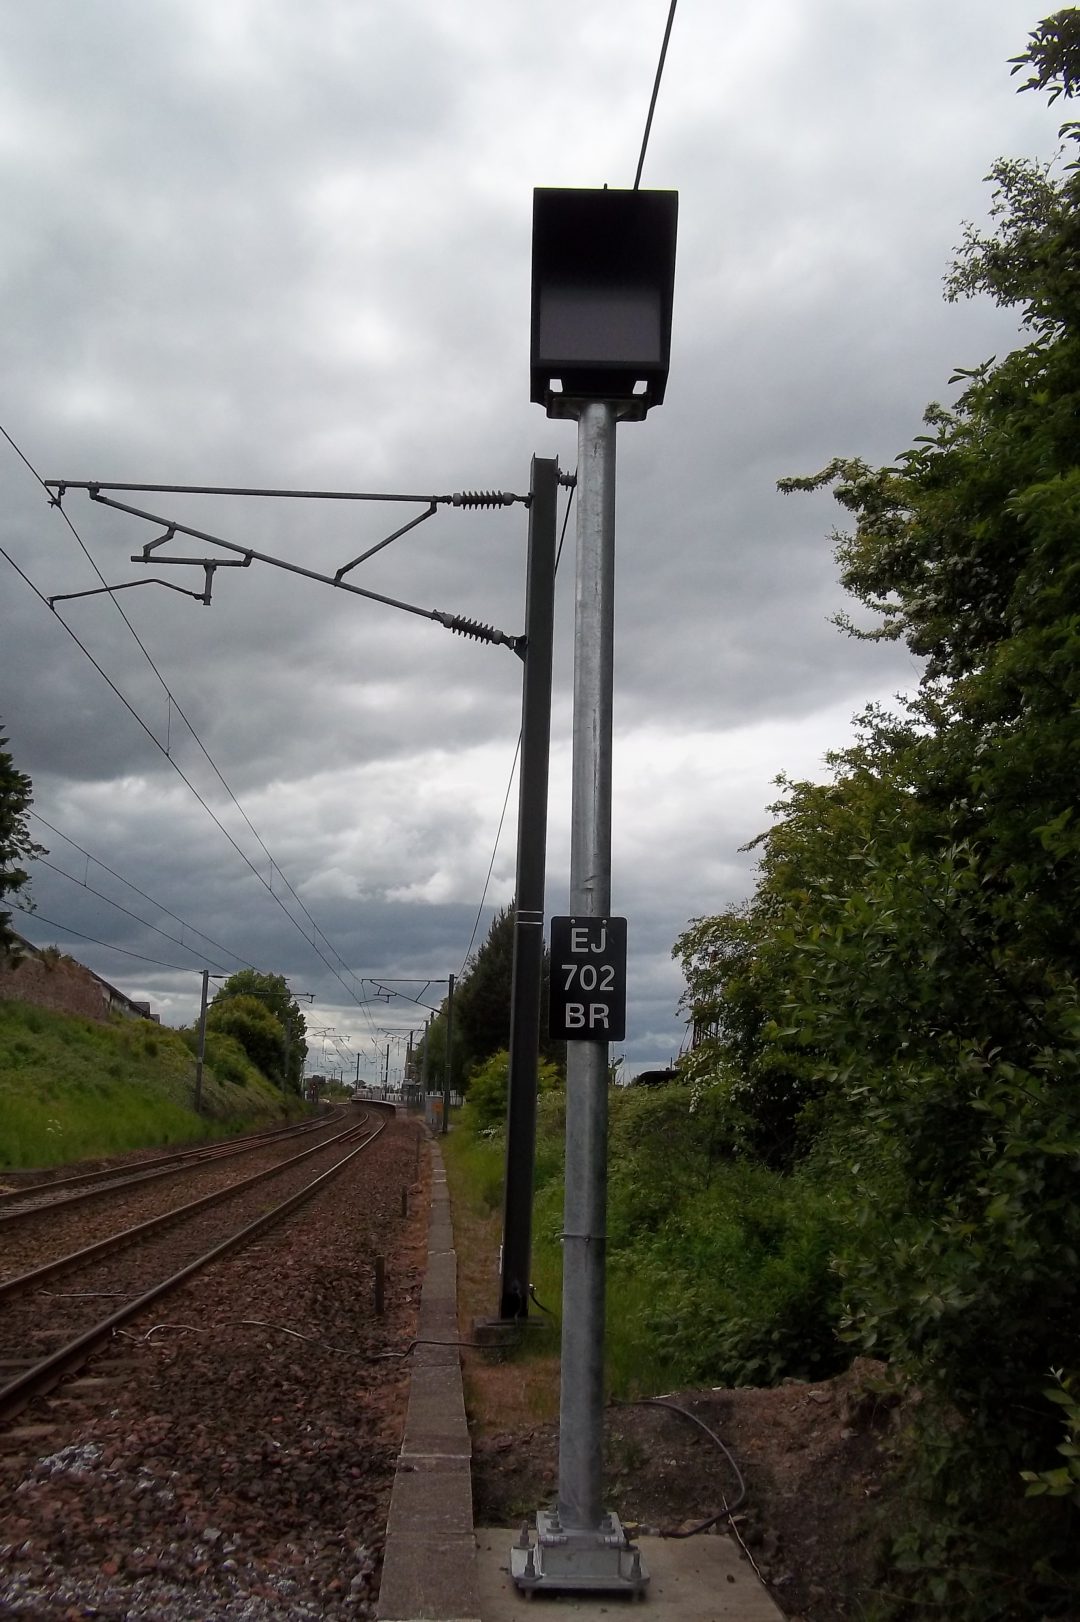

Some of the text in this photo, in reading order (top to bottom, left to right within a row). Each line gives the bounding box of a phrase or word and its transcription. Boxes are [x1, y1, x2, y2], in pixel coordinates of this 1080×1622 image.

[571, 927, 606, 953] EJ
[561, 964, 615, 991] 702
[565, 1002, 609, 1029] BR
